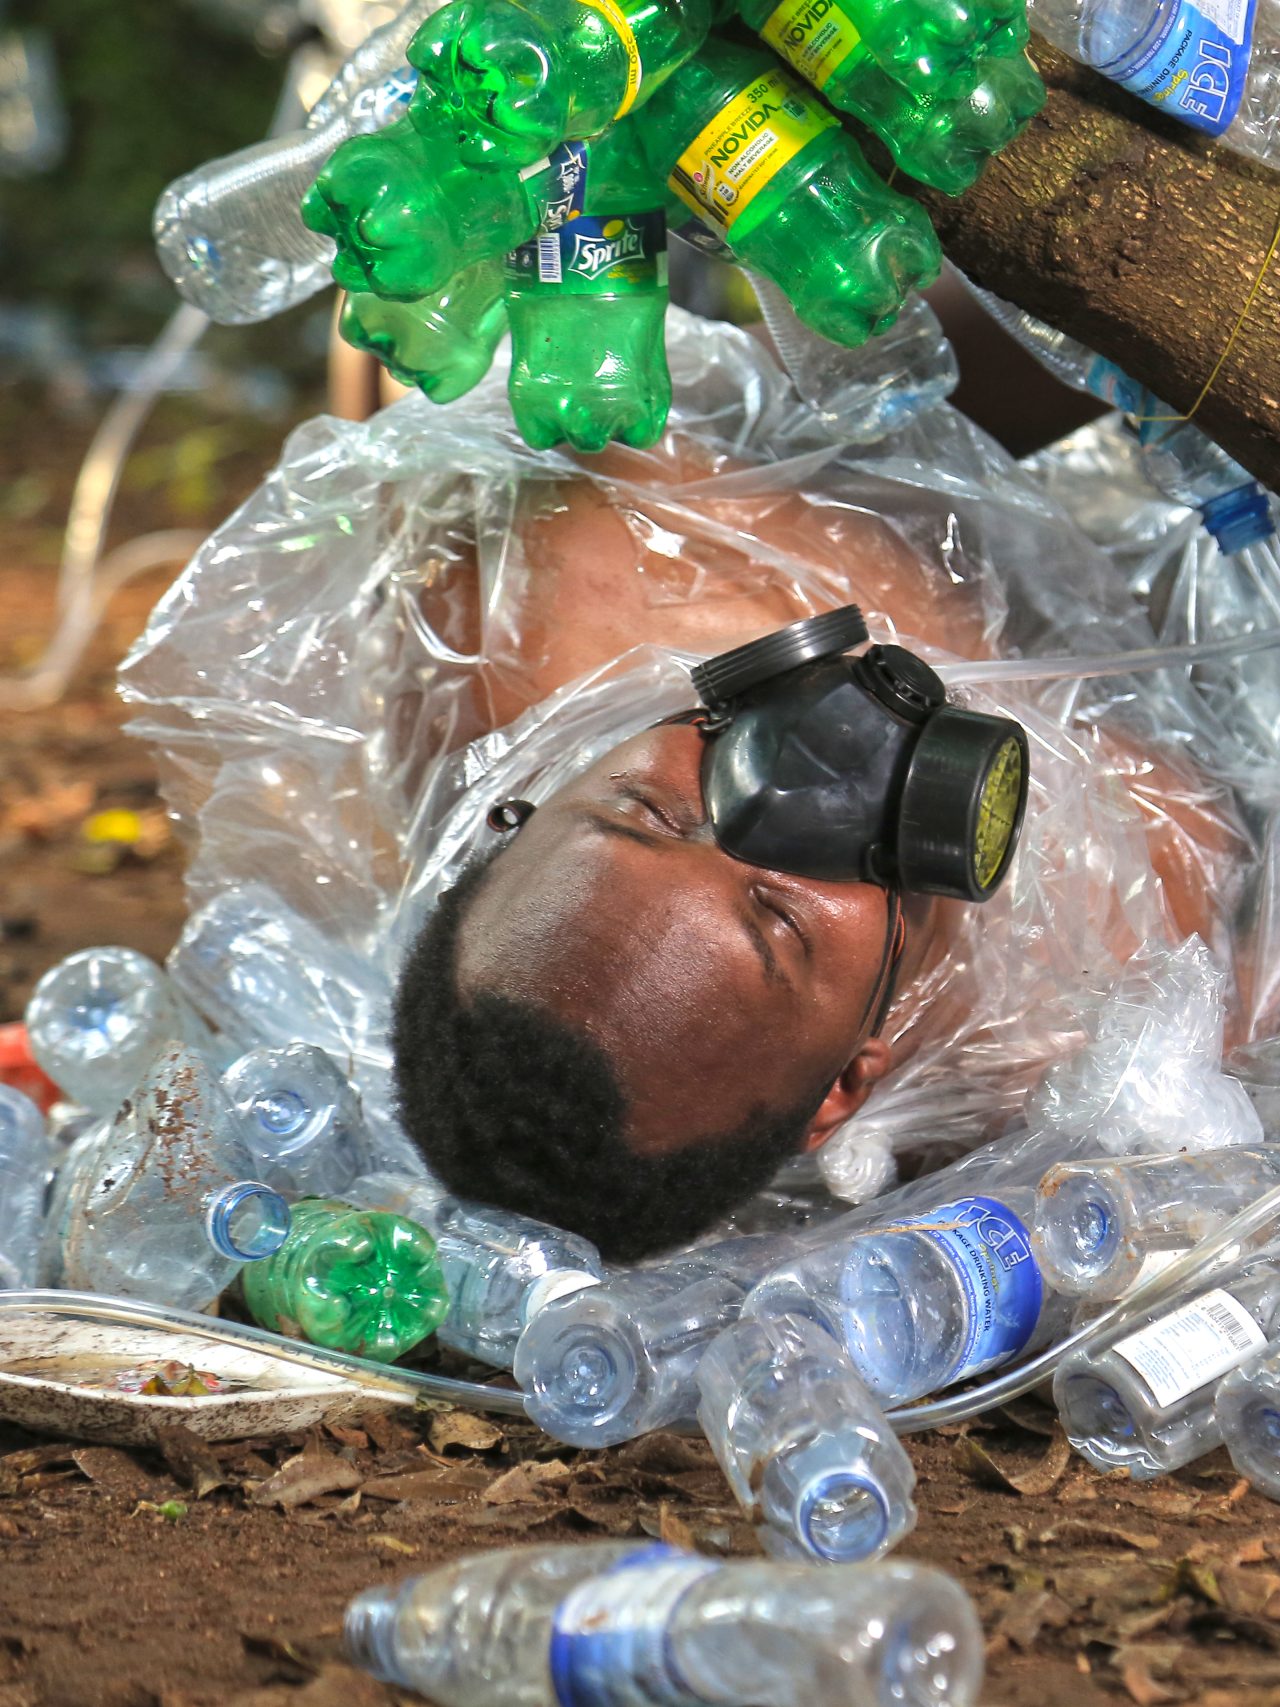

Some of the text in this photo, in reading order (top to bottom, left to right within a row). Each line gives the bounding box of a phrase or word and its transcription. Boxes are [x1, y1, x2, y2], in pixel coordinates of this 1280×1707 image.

[1170, 29, 1193, 68] PACKAGE
[630, 69, 637, 84] ml
[747, 83, 769, 103] 350
[1180, 38, 1231, 122] ICE
[704, 107, 753, 156] PINEAPPLE BREEZE
[710, 103, 780, 168] NOVIDA
[728, 132, 770, 175] NON-ALCOHOLIC
[734, 137, 775, 179] MALT BEVERAGE
[577, 232, 638, 272] Sprite
[955, 1205, 1030, 1273] ICE
[969, 1249, 990, 1297] DRINKING
[983, 1298, 993, 1332] WATER
